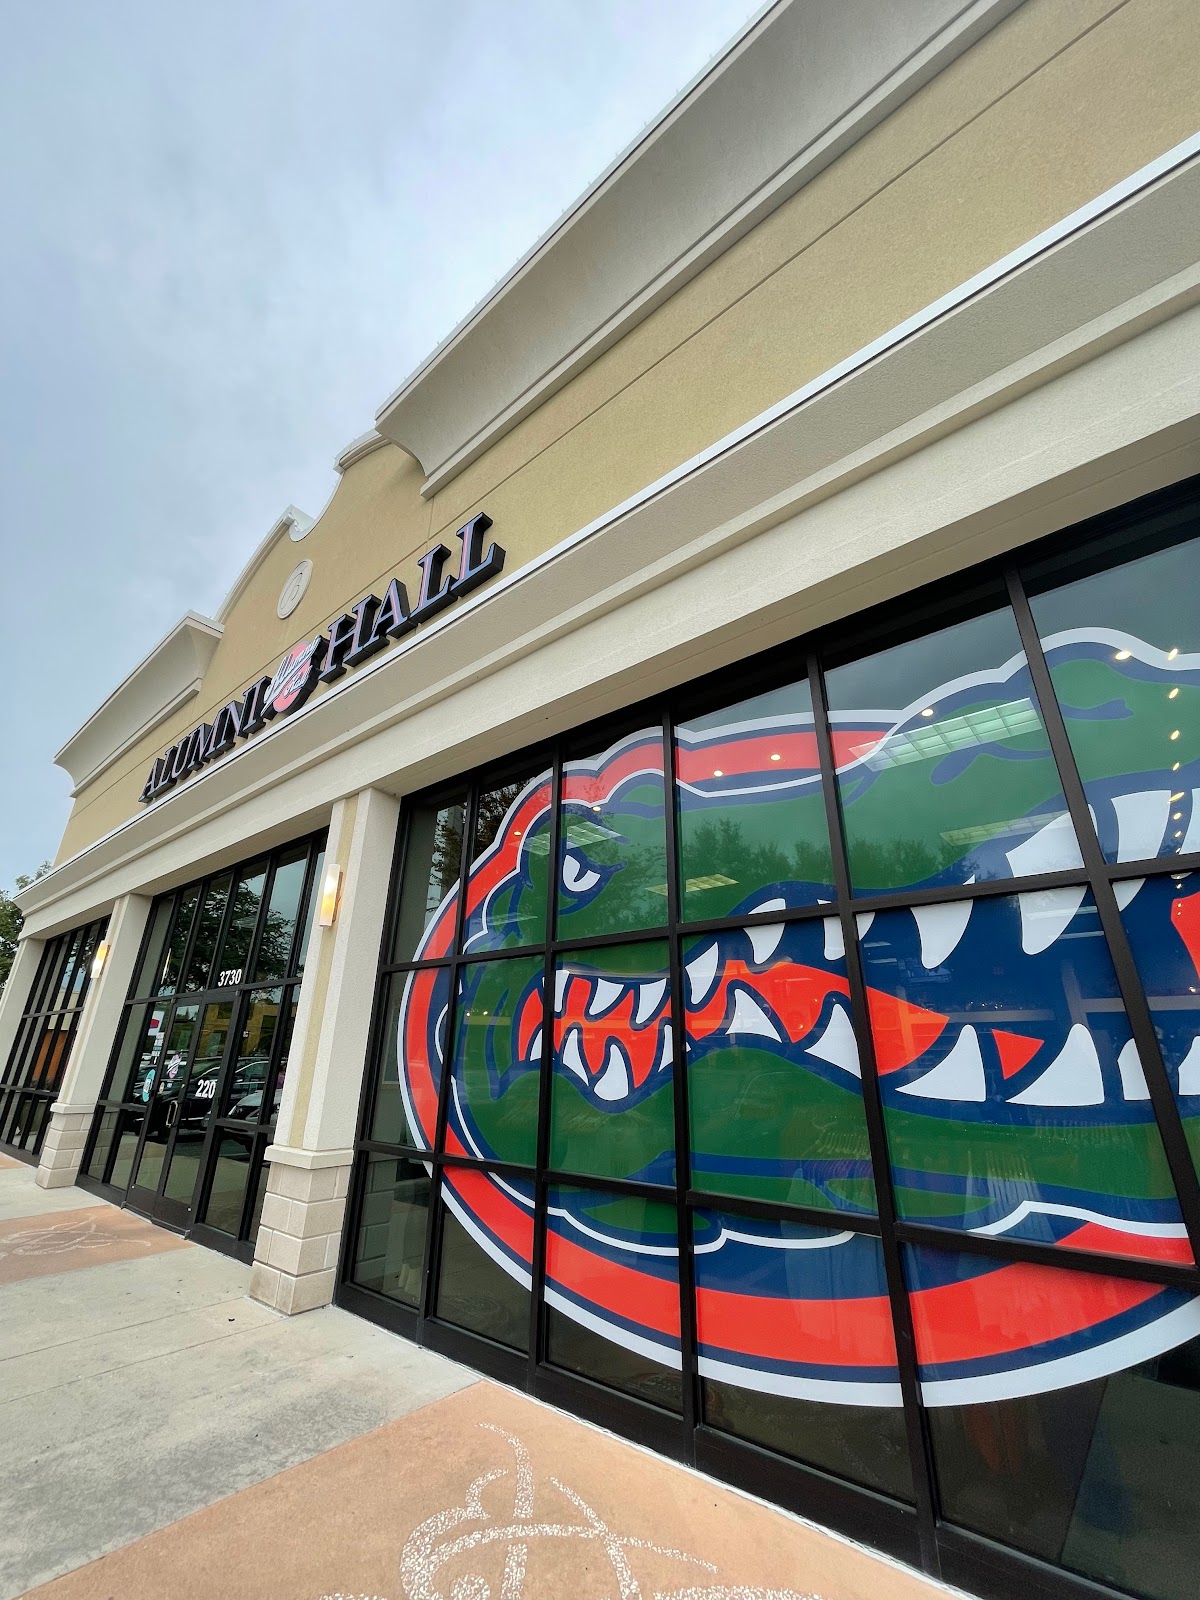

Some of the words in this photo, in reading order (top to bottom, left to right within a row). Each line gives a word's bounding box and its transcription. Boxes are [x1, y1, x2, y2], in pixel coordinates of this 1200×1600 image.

[139, 676, 270, 802] ALUMNI
[319, 512, 505, 682] HALL
[217, 968, 242, 987] 3730
[195, 1079, 216, 1099] 220
